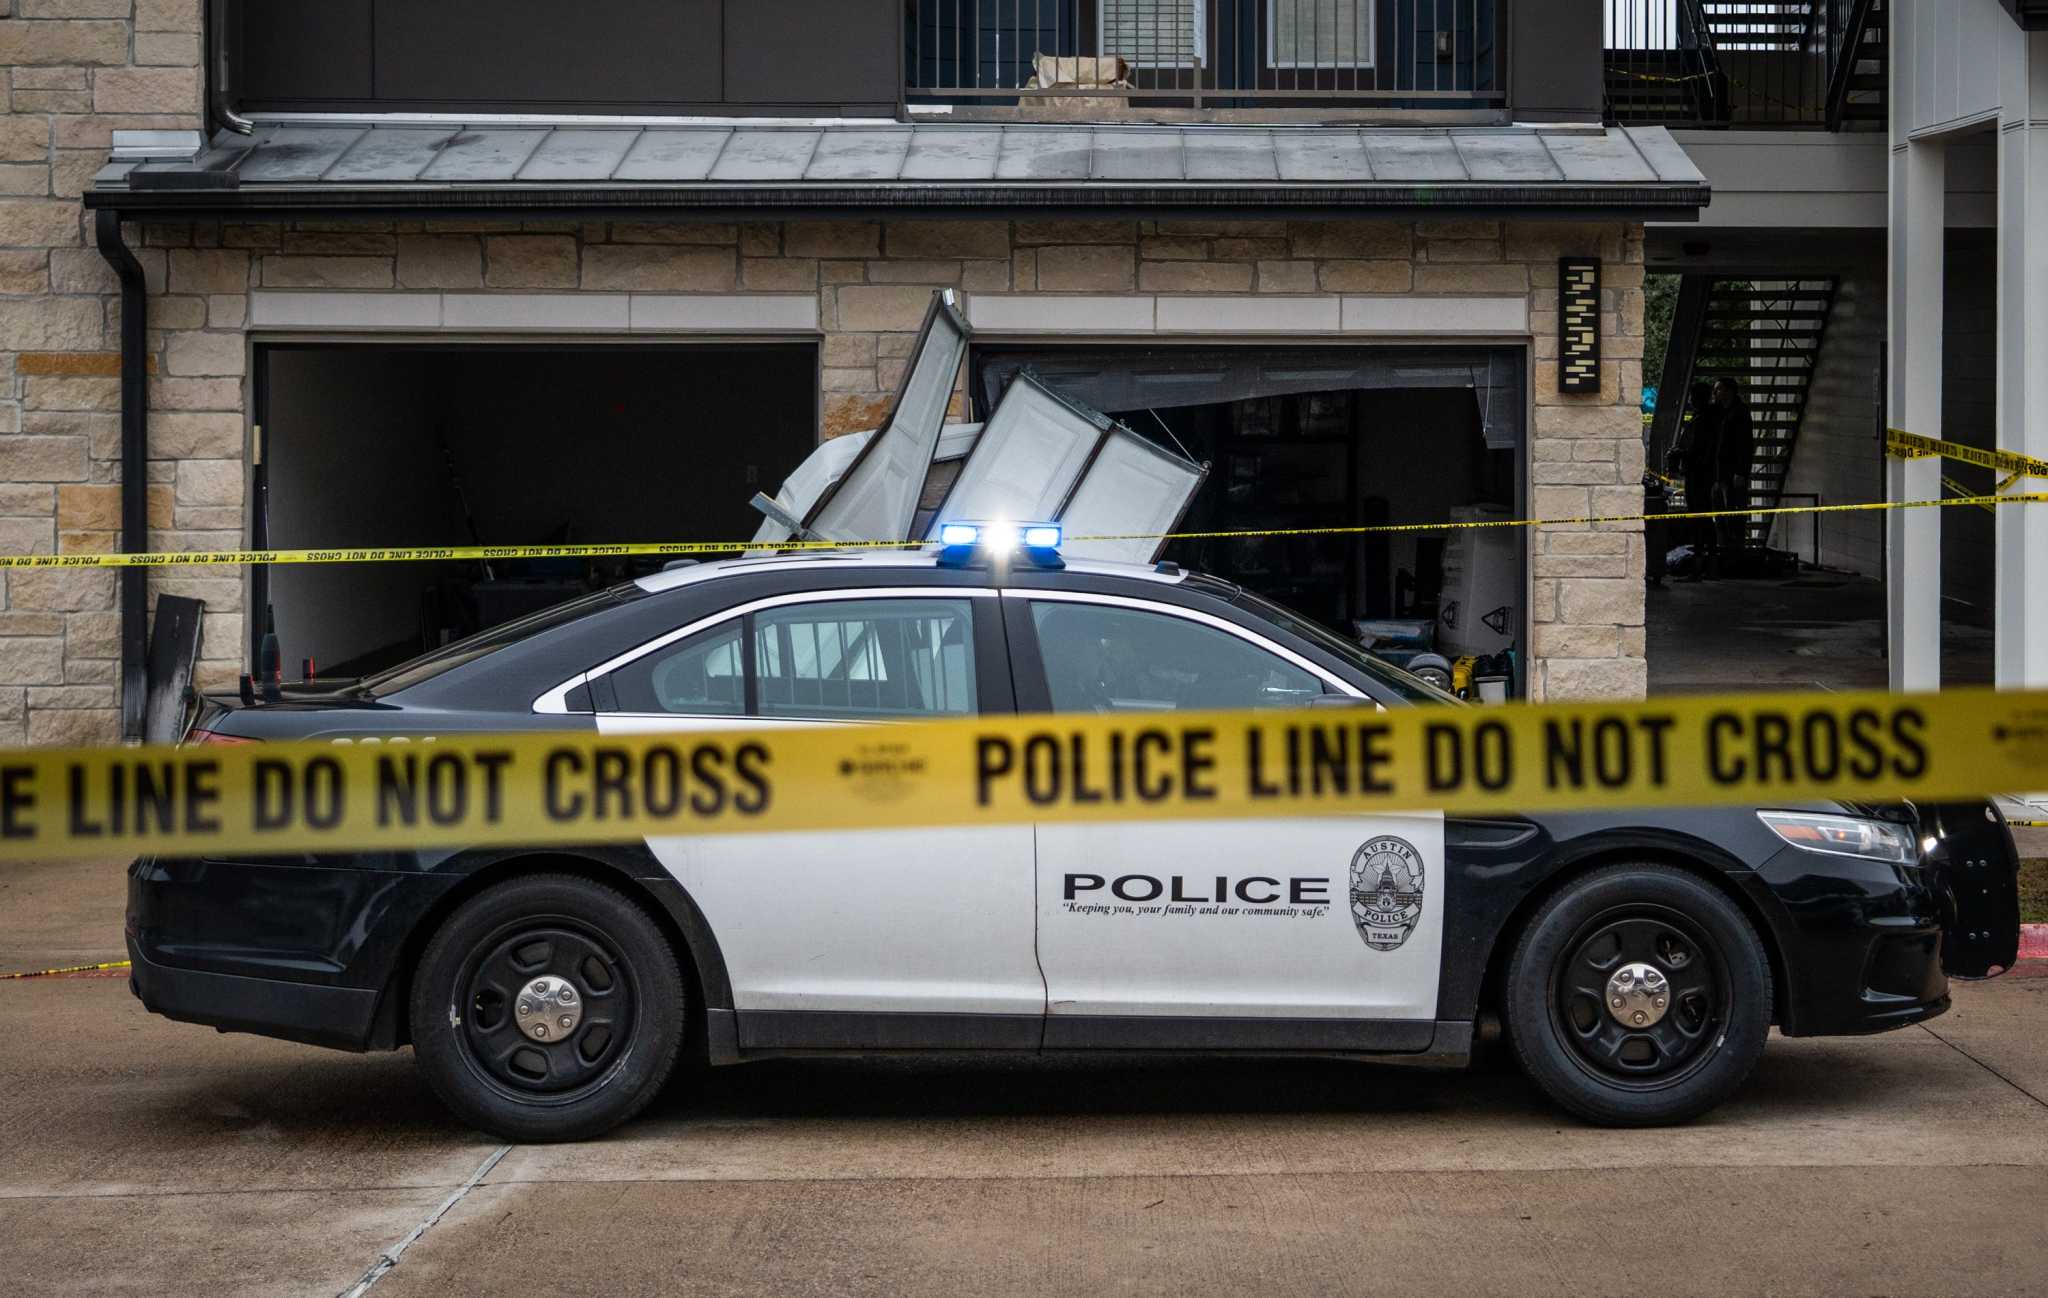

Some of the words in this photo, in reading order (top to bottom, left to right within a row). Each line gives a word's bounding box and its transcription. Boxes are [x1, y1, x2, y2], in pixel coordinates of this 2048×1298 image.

[168, 554, 191, 563] NOT
[193, 554, 209, 563] DO
[212, 553, 236, 562] LINE
[239, 553, 277, 562] POLICE
[306, 551, 342, 561] CROSS
[346, 551, 368, 560] NOT
[369, 551, 385, 559] DO
[389, 550, 412, 559] LINE
[415, 550, 454, 559] POLICE
[16, 558, 32, 566] DO
[35, 557, 59, 566] LINE
[62, 556, 101, 566] POLICE
[129, 555, 166, 564] CROSS
[976, 728, 1219, 807] POLICE
[1246, 723, 1396, 797] LINE
[1424, 719, 1513, 794] DO
[1543, 712, 1676, 790] NOT
[1705, 707, 1929, 786] CROSS
[68, 758, 221, 838] LINE
[251, 753, 346, 832] DO
[376, 750, 513, 828] NOT
[543, 741, 773, 823] CROSS
[1363, 842, 1412, 860] AUSTIN
[1064, 873, 1330, 905] POLICE
[1112, 905, 1135, 915] you,
[1136, 906, 1162, 916] your
[1162, 904, 1197, 917] family
[1199, 905, 1219, 915] and
[1221, 907, 1240, 915] our
[1242, 906, 1299, 918] community
[1364, 910, 1408, 923] POLICE
[1372, 932, 1398, 940] TEXAS
